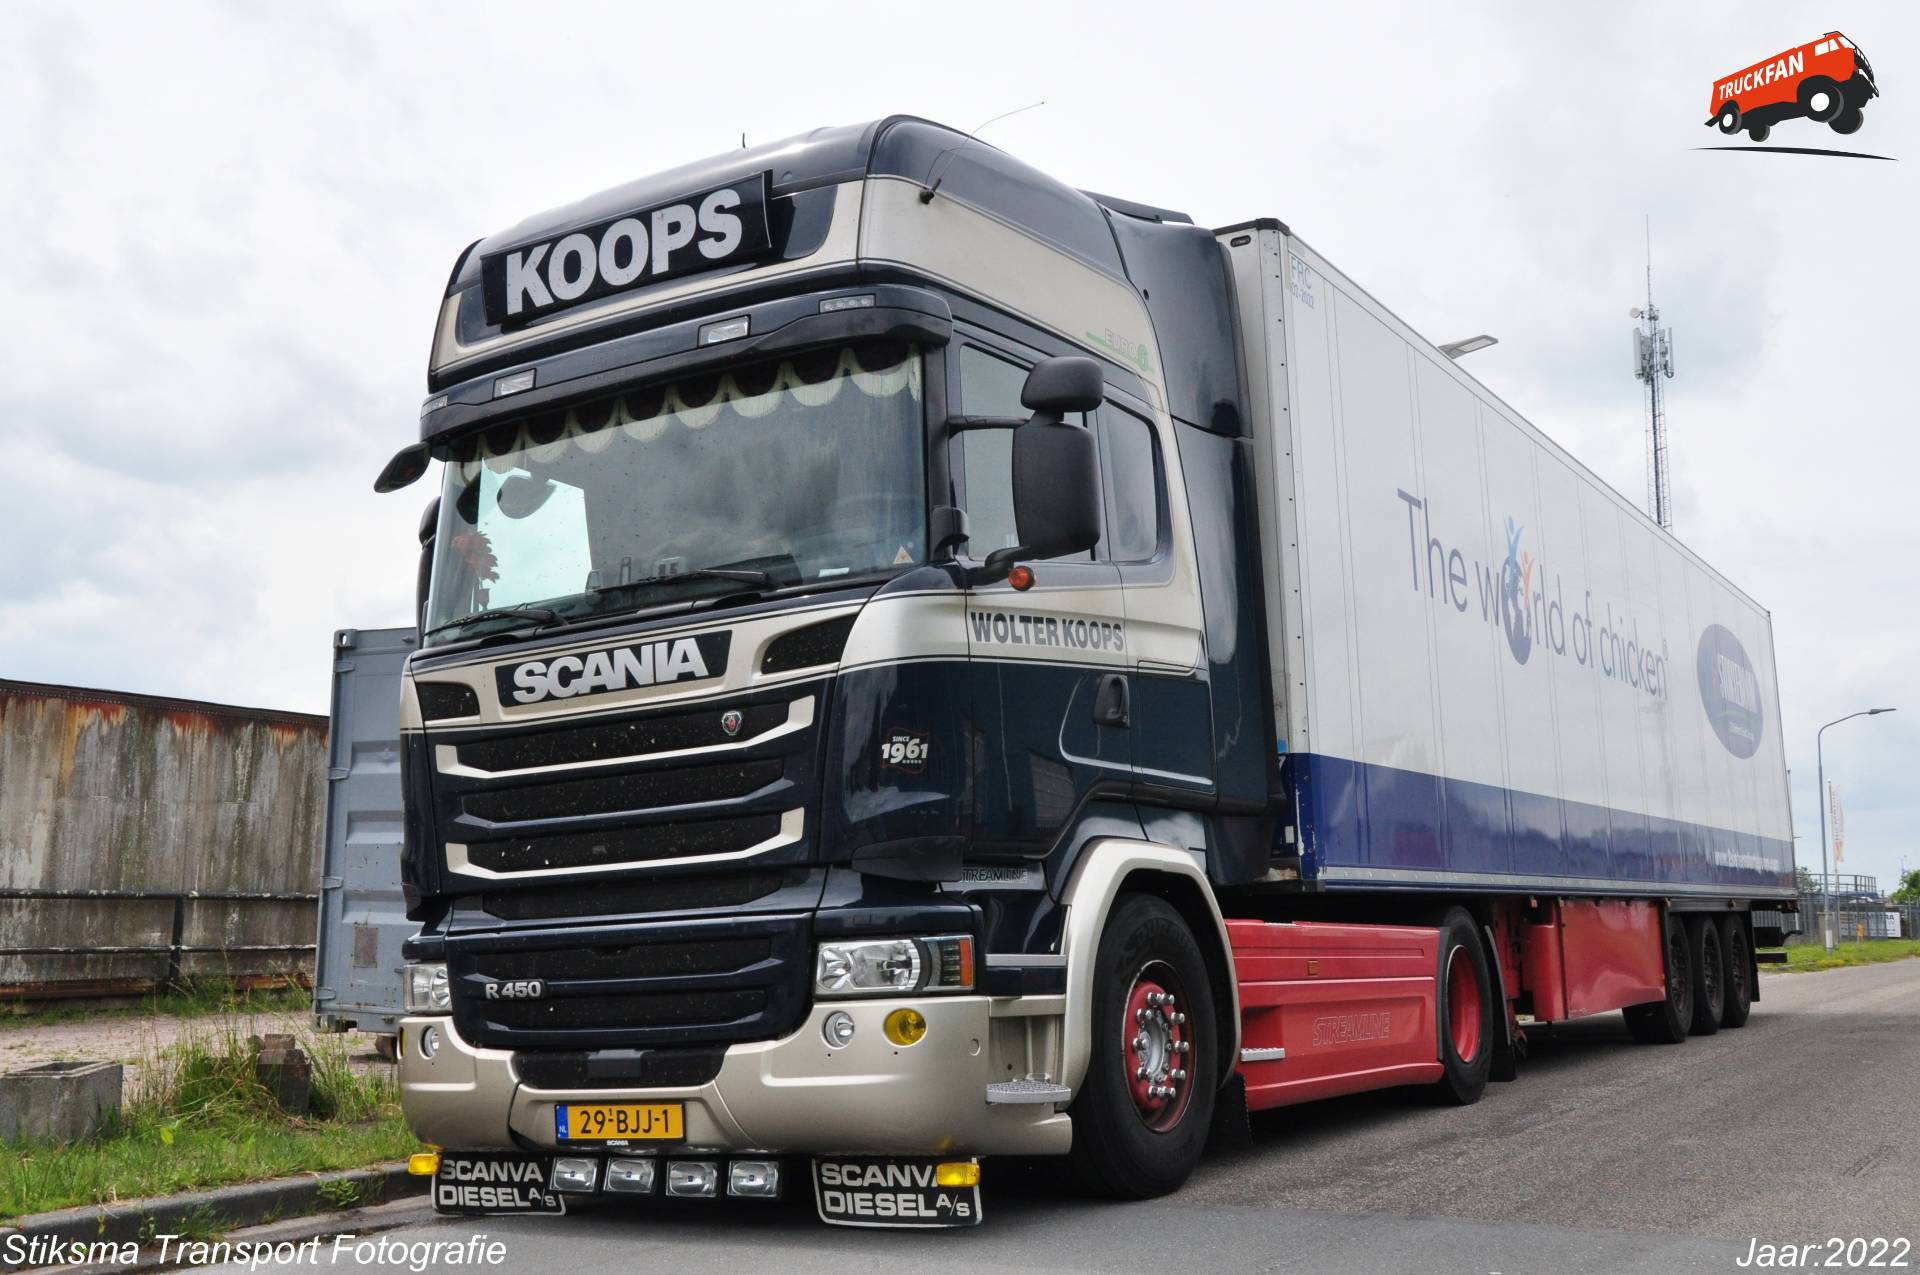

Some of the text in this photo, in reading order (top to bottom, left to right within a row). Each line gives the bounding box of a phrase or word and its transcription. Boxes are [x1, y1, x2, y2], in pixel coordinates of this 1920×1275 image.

[506, 189, 742, 315] KOOPS
[1397, 487, 1468, 612] The
[1475, 548, 1566, 666] world
[1572, 590, 1594, 669] of
[1600, 603, 1668, 700] chicken
[970, 612, 1124, 651] WOLTER KOOPS
[512, 637, 709, 703] SCANIA
[881, 738, 929, 764] 1961
[485, 981, 541, 999] R 450
[1313, 1012, 1391, 1047] STREAMLINE
[580, 1108, 669, 1134] 29-BJJ-1
[440, 1160, 544, 1182] SCANVA
[821, 1163, 941, 1187] SCANV
[439, 1185, 531, 1207] DIESEL
[824, 1191, 971, 1217] DIESEL A/S
